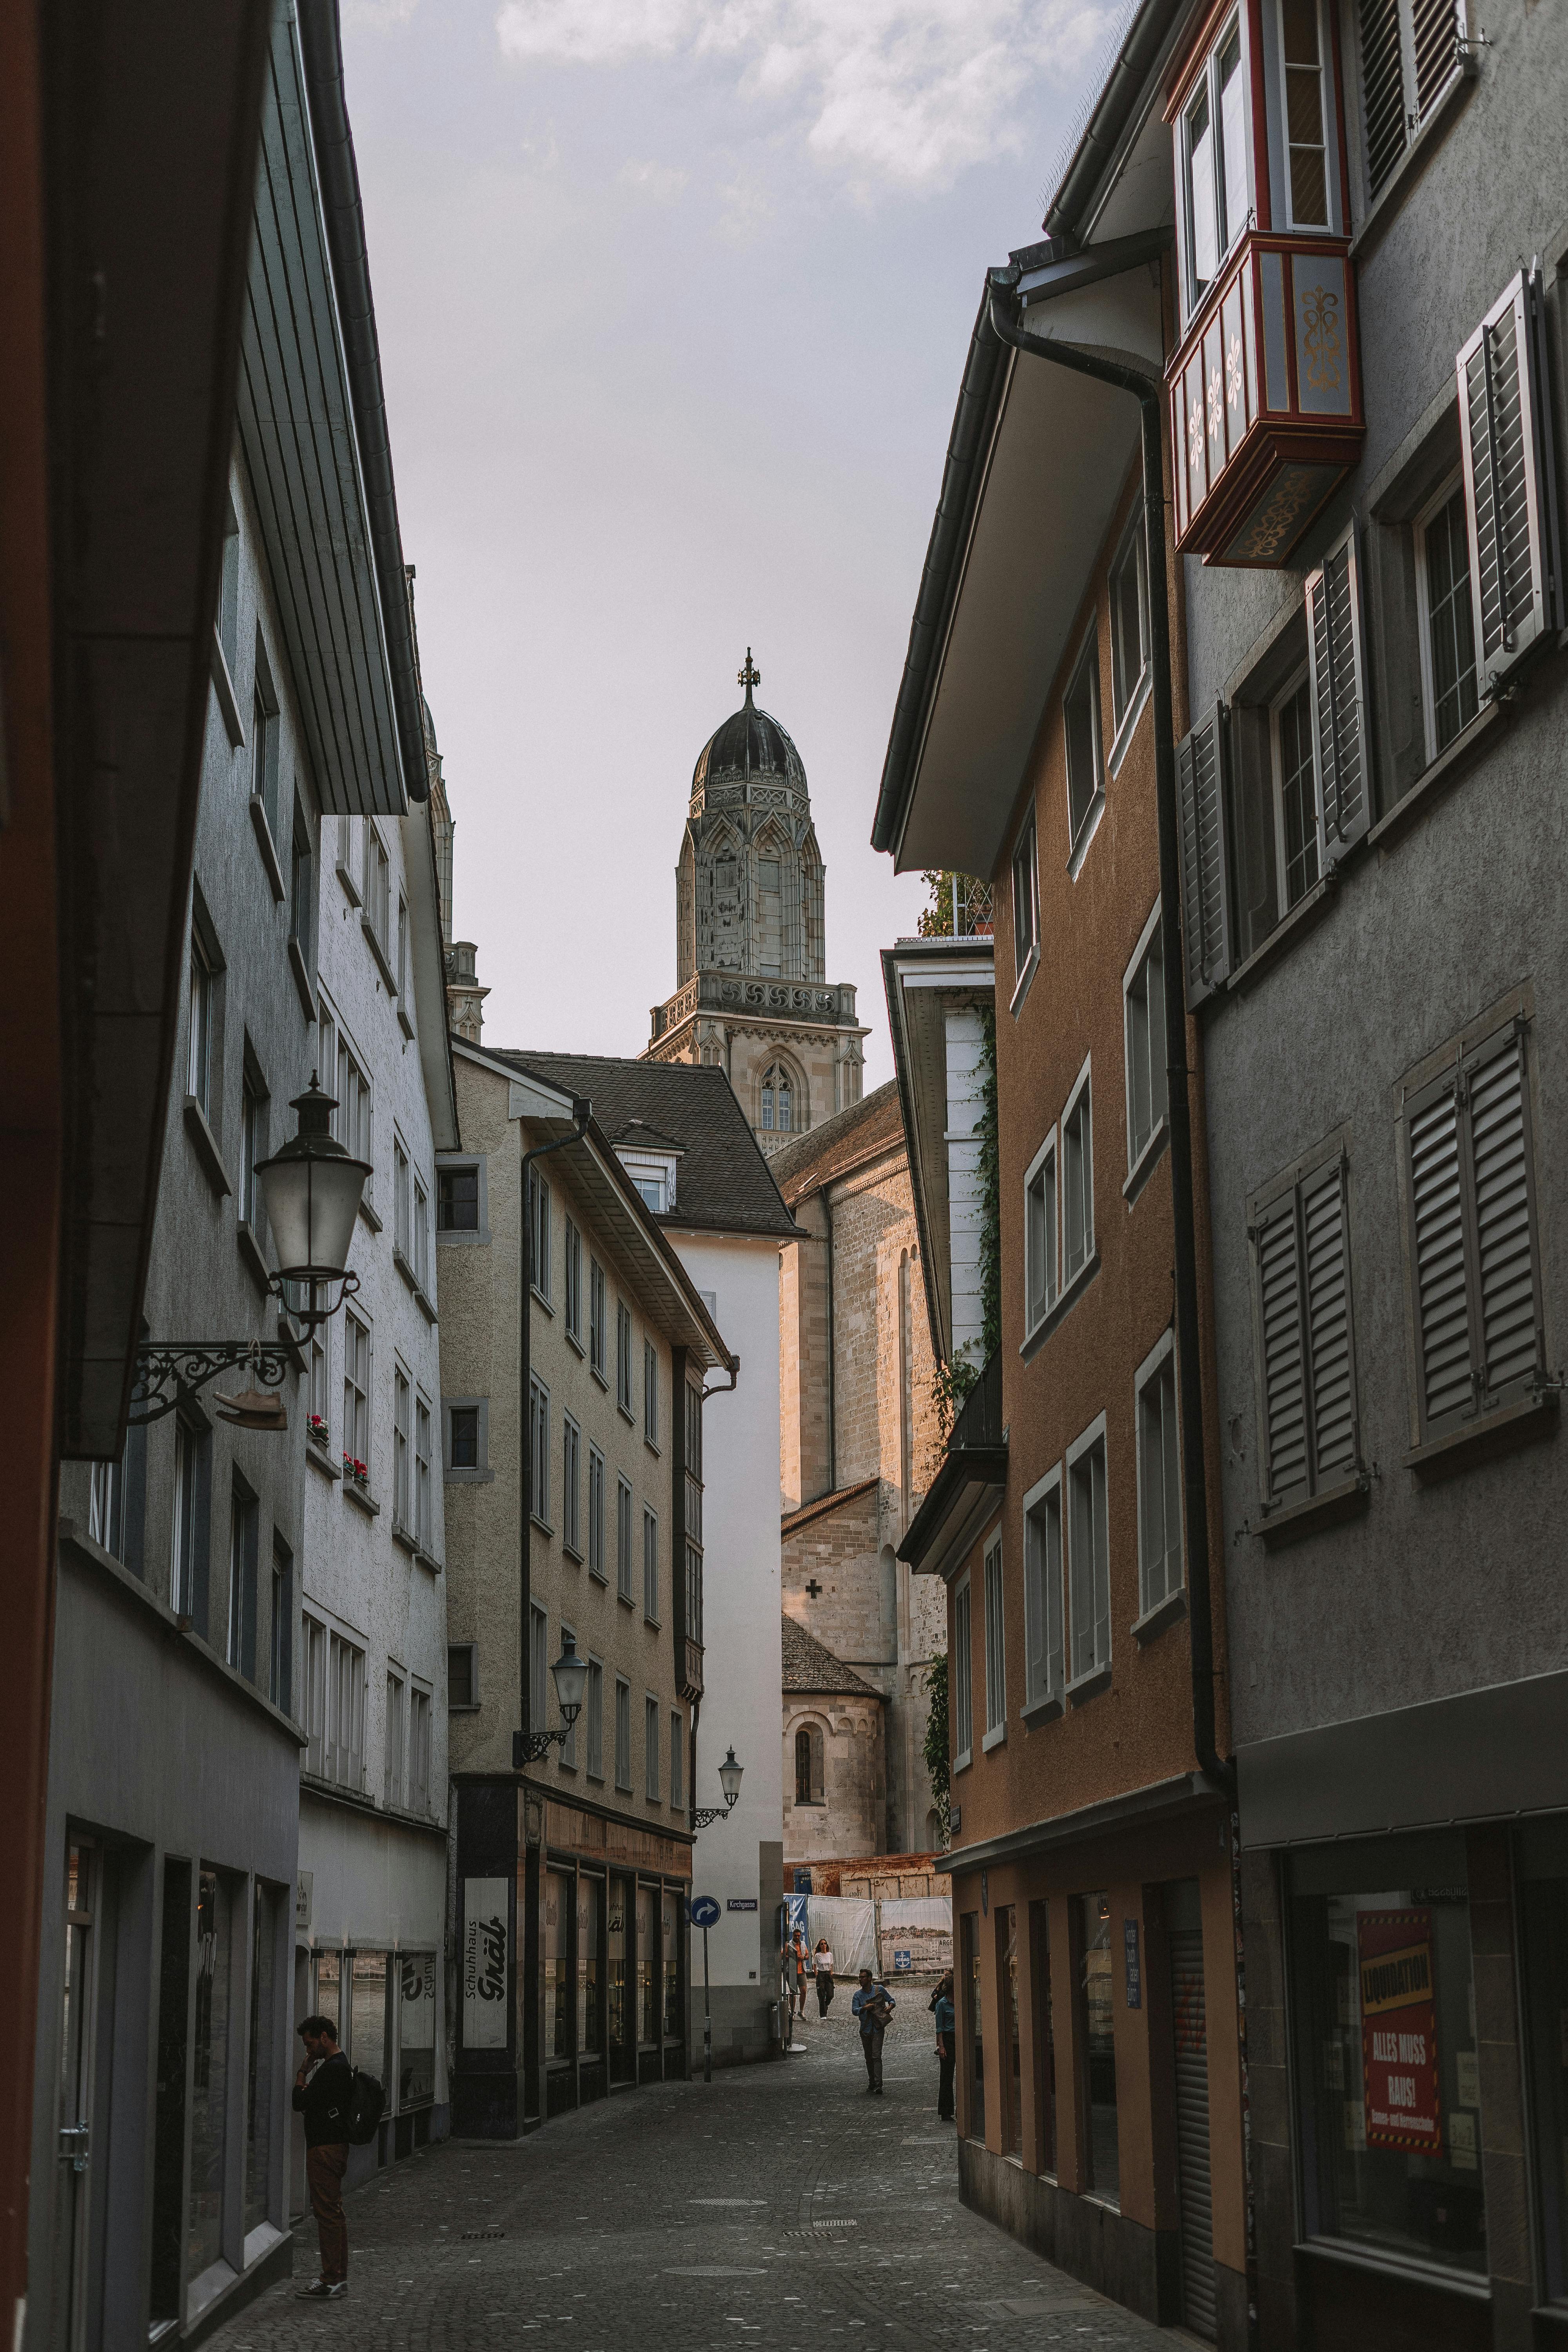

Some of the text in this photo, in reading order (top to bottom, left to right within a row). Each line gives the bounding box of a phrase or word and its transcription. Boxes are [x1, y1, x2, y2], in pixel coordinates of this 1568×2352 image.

[730, 1900, 755, 1909] Kirchgasse
[789, 1921, 805, 1933] IBAG
[465, 1920, 477, 2000] Schuhhaus
[477, 1916, 507, 2002] Gräb
[1363, 1953, 1429, 2005] LIQUIDATION
[1373, 2032, 1426, 2065] ALLES MUSS
[1387, 2076, 1416, 2108] RAUS!
